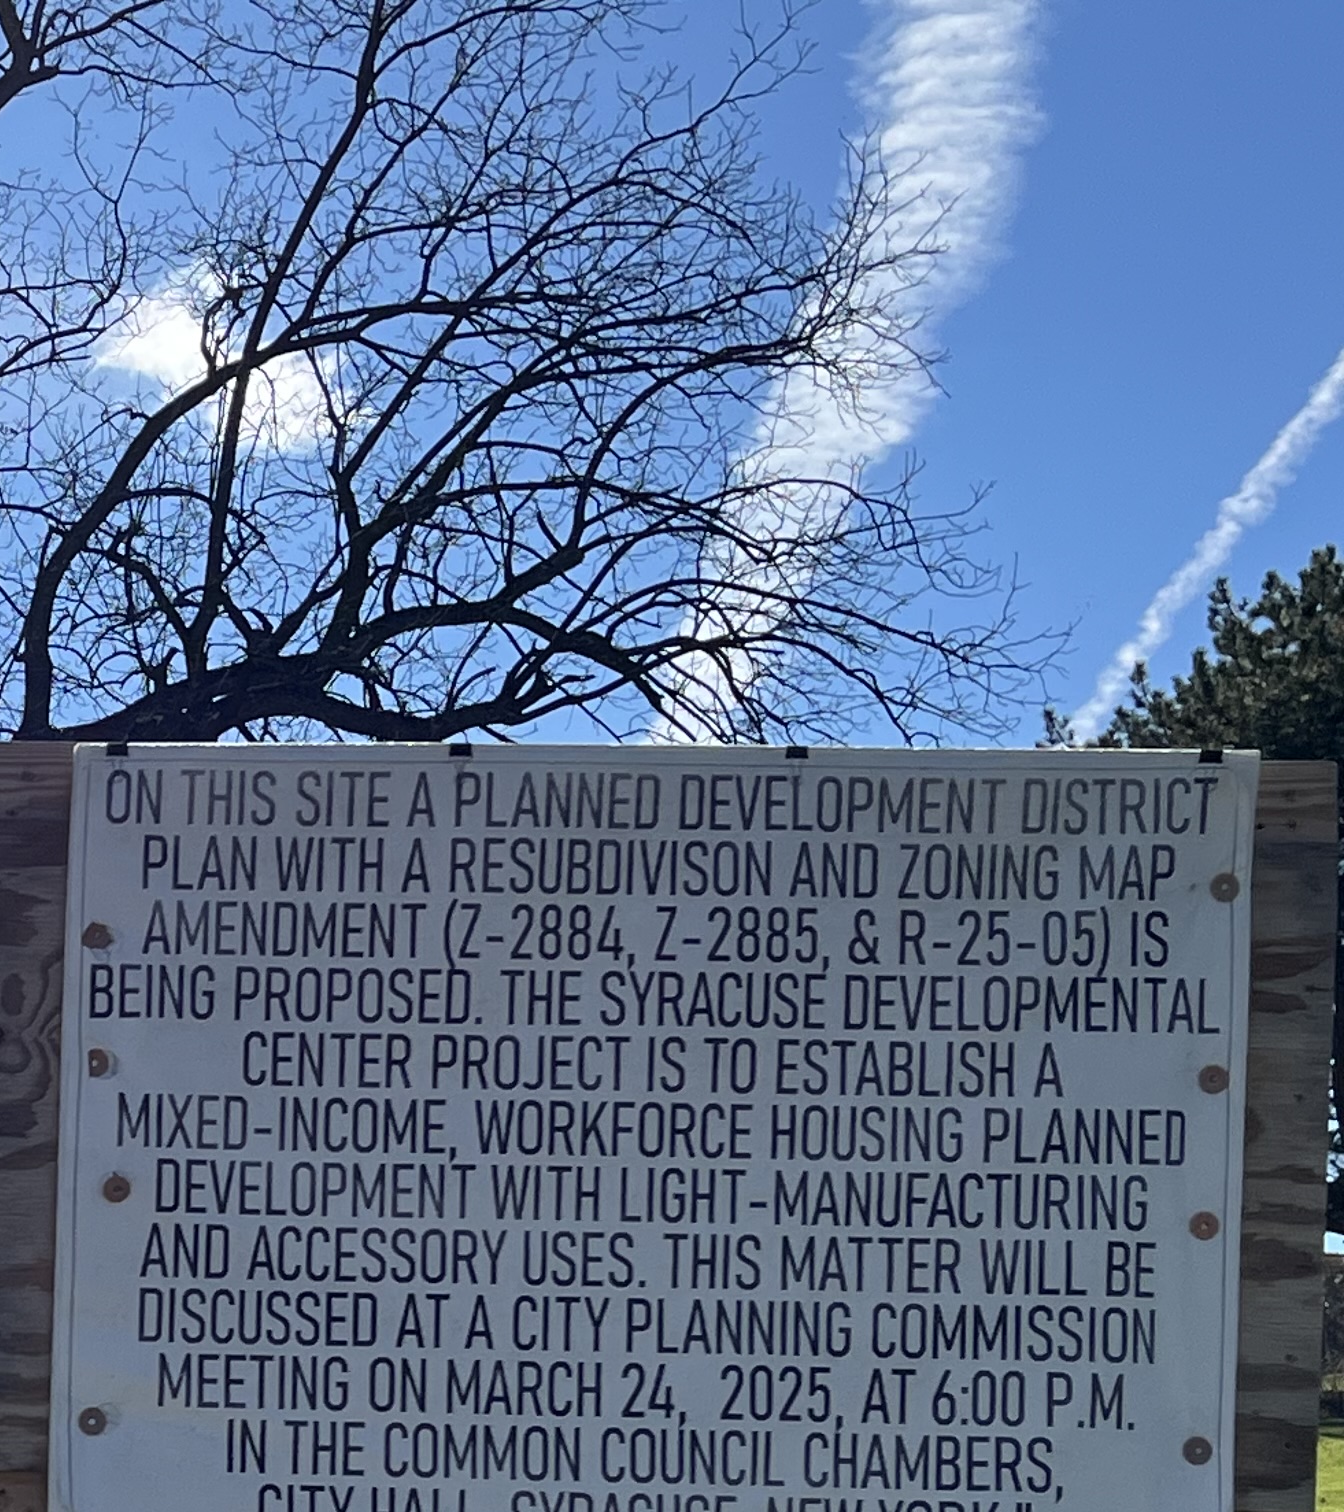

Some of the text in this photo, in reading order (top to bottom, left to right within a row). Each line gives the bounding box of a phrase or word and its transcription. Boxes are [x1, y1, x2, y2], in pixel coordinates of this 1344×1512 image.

[105, 768, 1220, 836] ON THIS SITE A PLANNED DEVELOPMENT DISTRICT
[142, 834, 1176, 902] PLAN WITH A RESUBDIVISON AND ZONING MAP
[141, 899, 1170, 976] AMENDMENT (Z-2884, Z-2885, & R-25-05) IS
[88, 963, 1221, 1035] BEING PROPOSED. THE SYRACUSE DEVELOPMENTAL
[242, 1030, 1064, 1099] CENTER PROJECT IS TO ESTABLISH A
[116, 1091, 1186, 1167] MIXED-INCOME, WORKFORCE HOUSING PLANNED
[154, 1157, 1149, 1233] DEVELOPMENT WITH LIGHT-MANUFACTURING
[138, 1222, 1157, 1299] AND ACCESSORY USES. THIS MATTER WILL BE
[137, 1287, 1157, 1365] DISCUSSED AT A CITY PLANNING COMMISSION
[157, 1352, 1135, 1431] MEETING ON MARCH 24, 2025, AT 6:00 P.M.
[226, 1418, 1064, 1504] IN THE COMMON COUNCIL CHAMBERS,
